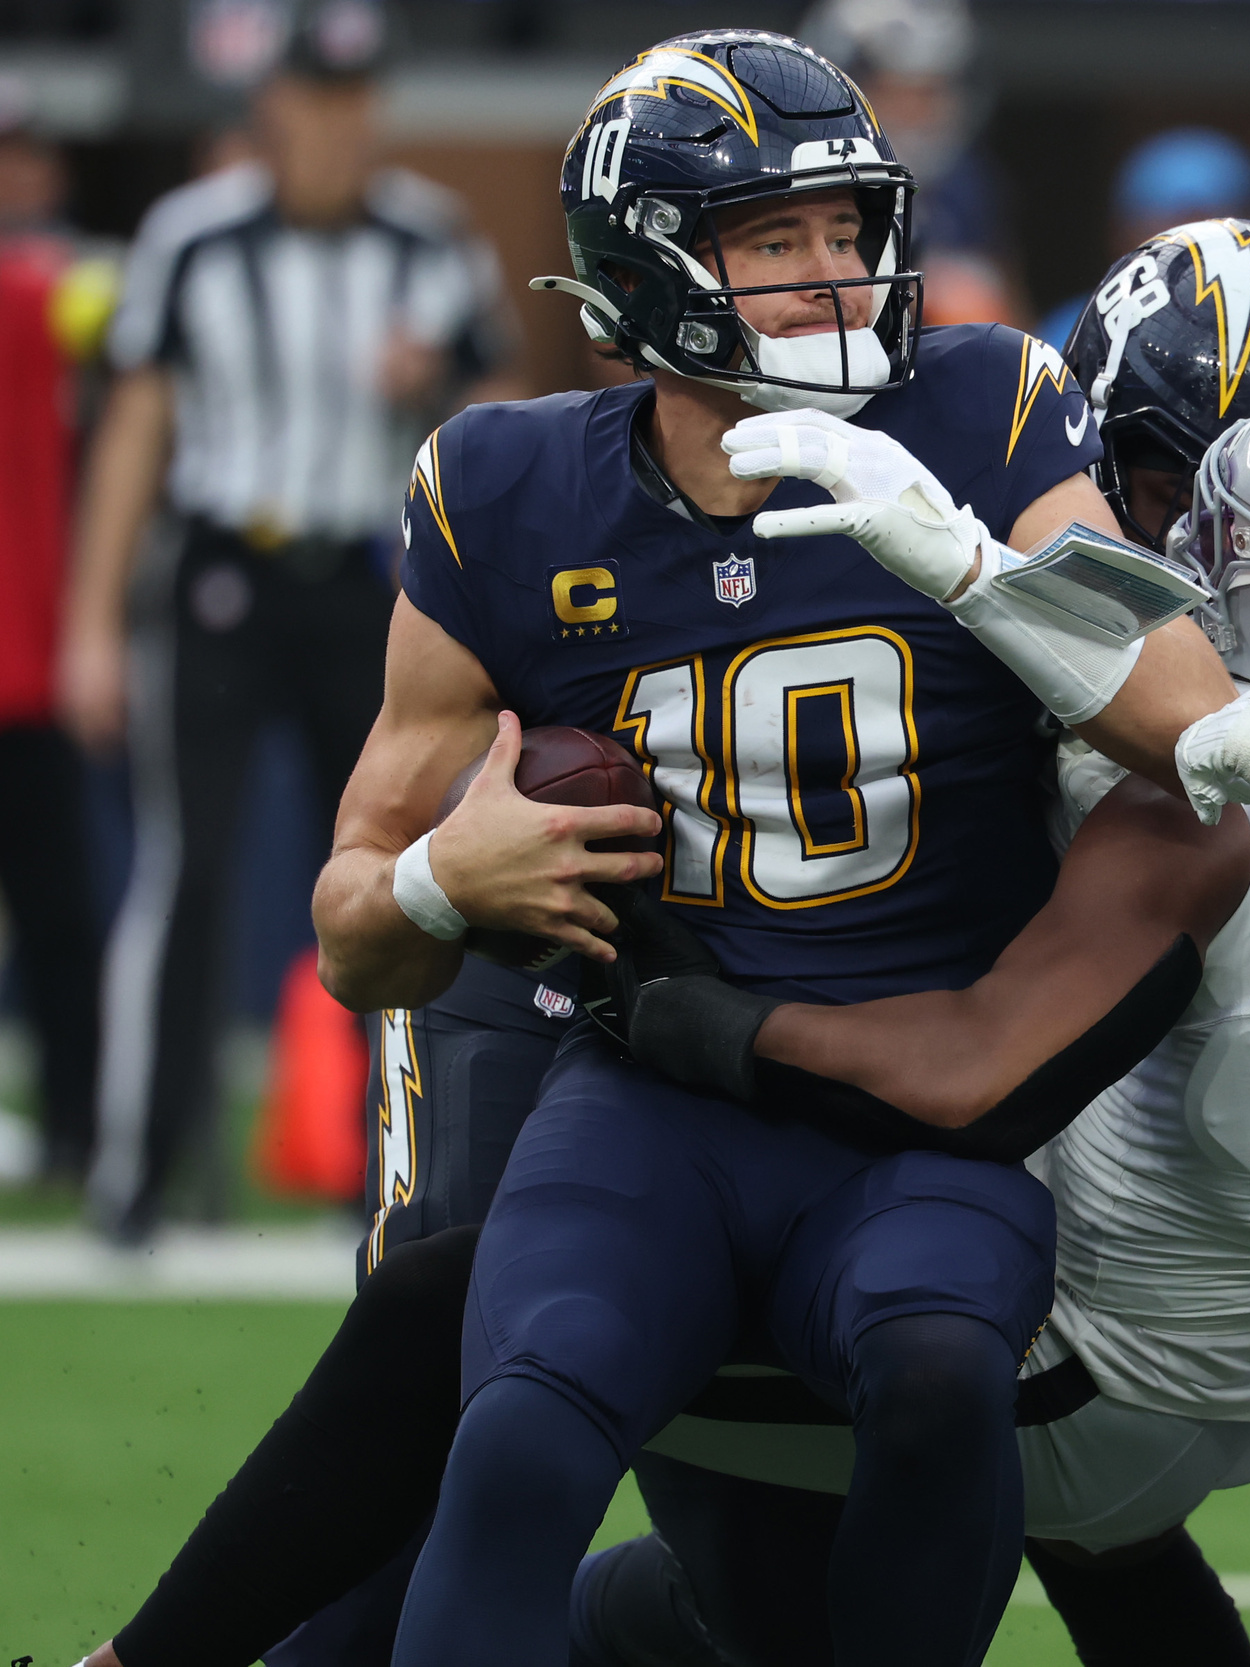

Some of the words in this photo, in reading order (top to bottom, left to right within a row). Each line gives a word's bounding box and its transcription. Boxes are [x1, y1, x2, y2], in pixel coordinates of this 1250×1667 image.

[581, 118, 632, 202] 10
[827, 139, 857, 163] LA
[1096, 255, 1171, 341] 68
[552, 567, 617, 624] C
[720, 577, 750, 599] NFL
[612, 625, 922, 910] 10
[541, 991, 569, 1012] NFL
